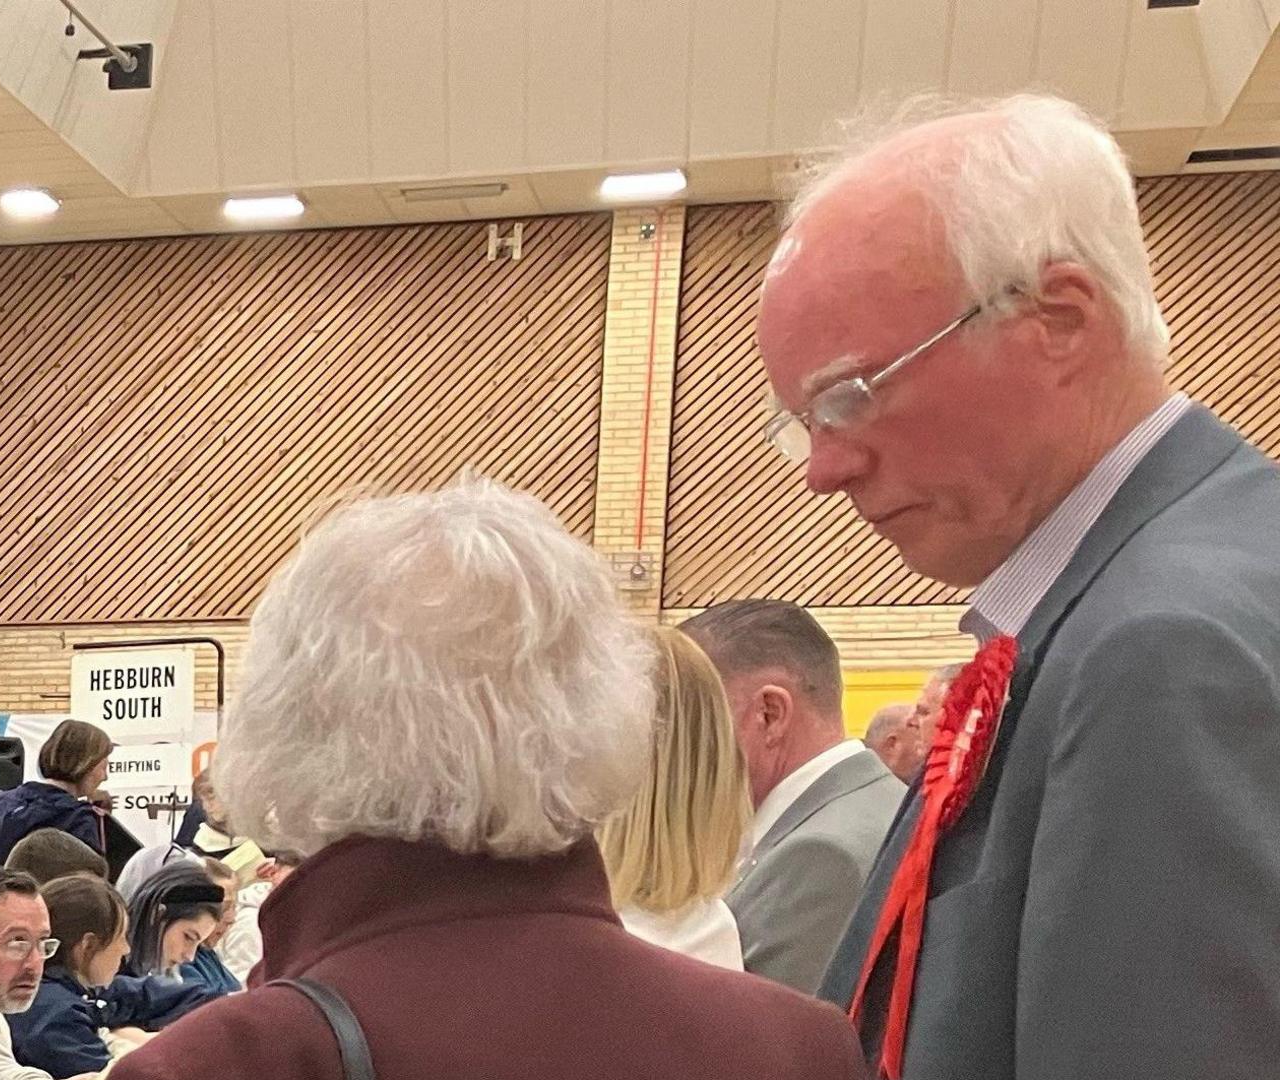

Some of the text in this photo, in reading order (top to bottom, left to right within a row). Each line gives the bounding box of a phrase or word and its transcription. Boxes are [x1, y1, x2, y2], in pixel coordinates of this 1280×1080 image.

[90, 666, 175, 691] HEBBURN
[103, 697, 162, 720] SOUTH
[108, 759, 161, 774] ERIFYING
